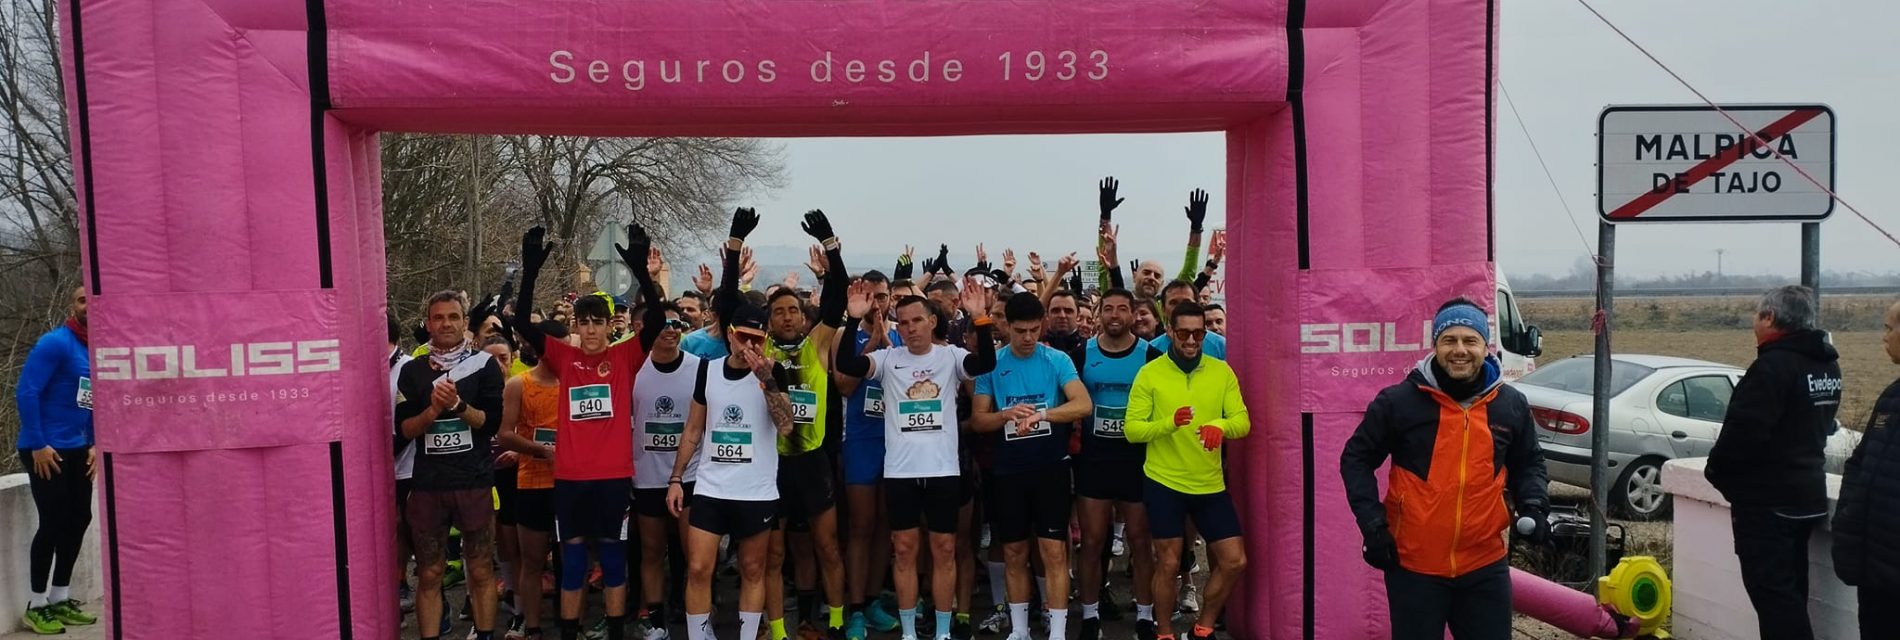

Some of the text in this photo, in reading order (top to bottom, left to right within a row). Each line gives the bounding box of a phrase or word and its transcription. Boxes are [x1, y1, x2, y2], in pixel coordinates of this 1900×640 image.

[550, 50, 1109, 91] Seguros desde 1933
[1635, 132, 1799, 161] MALPICA
[1652, 171, 1782, 195] DE TAJO
[1300, 317, 1497, 354] SOLI
[95, 339, 341, 380] SOLISS
[1331, 365, 1395, 378] Seguros
[123, 387, 310, 407] Seguros desde 1933
[579, 398, 603, 413] 640
[792, 403, 807, 417] 08
[908, 412, 935, 426] 564
[433, 432, 462, 447] 623
[652, 434, 677, 447] 649
[717, 444, 743, 457] 664
